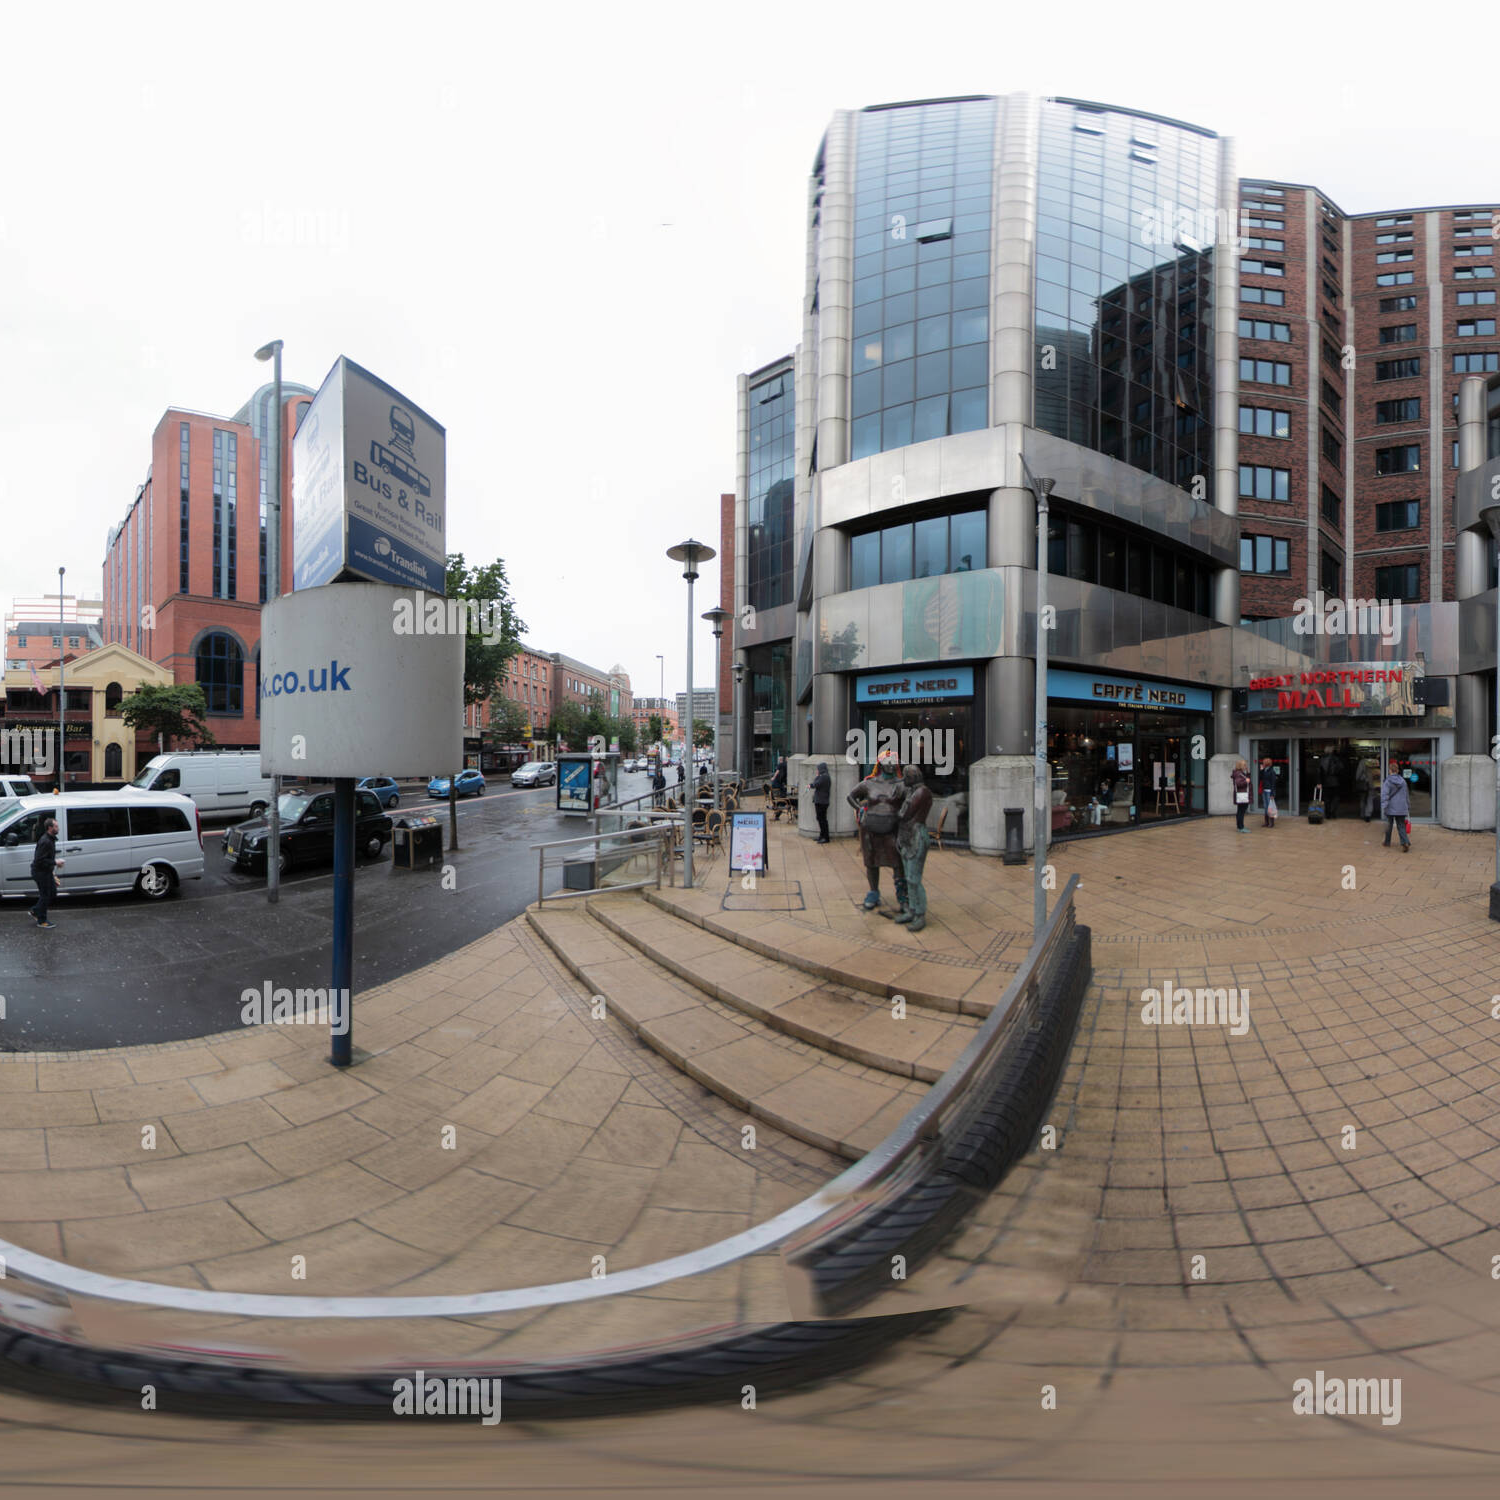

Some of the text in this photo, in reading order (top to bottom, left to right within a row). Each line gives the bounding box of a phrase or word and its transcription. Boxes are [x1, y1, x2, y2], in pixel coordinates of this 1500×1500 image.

[354, 461, 441, 533] Bus & Rail
[391, 549, 428, 580] Translink
[916, 679, 957, 692] NERO
[1250, 670, 1403, 690] GREAT NORTHERN
[1148, 688, 1186, 705] NERO
[1278, 688, 1361, 710] MALL
[66, 724, 84, 732] Bar
